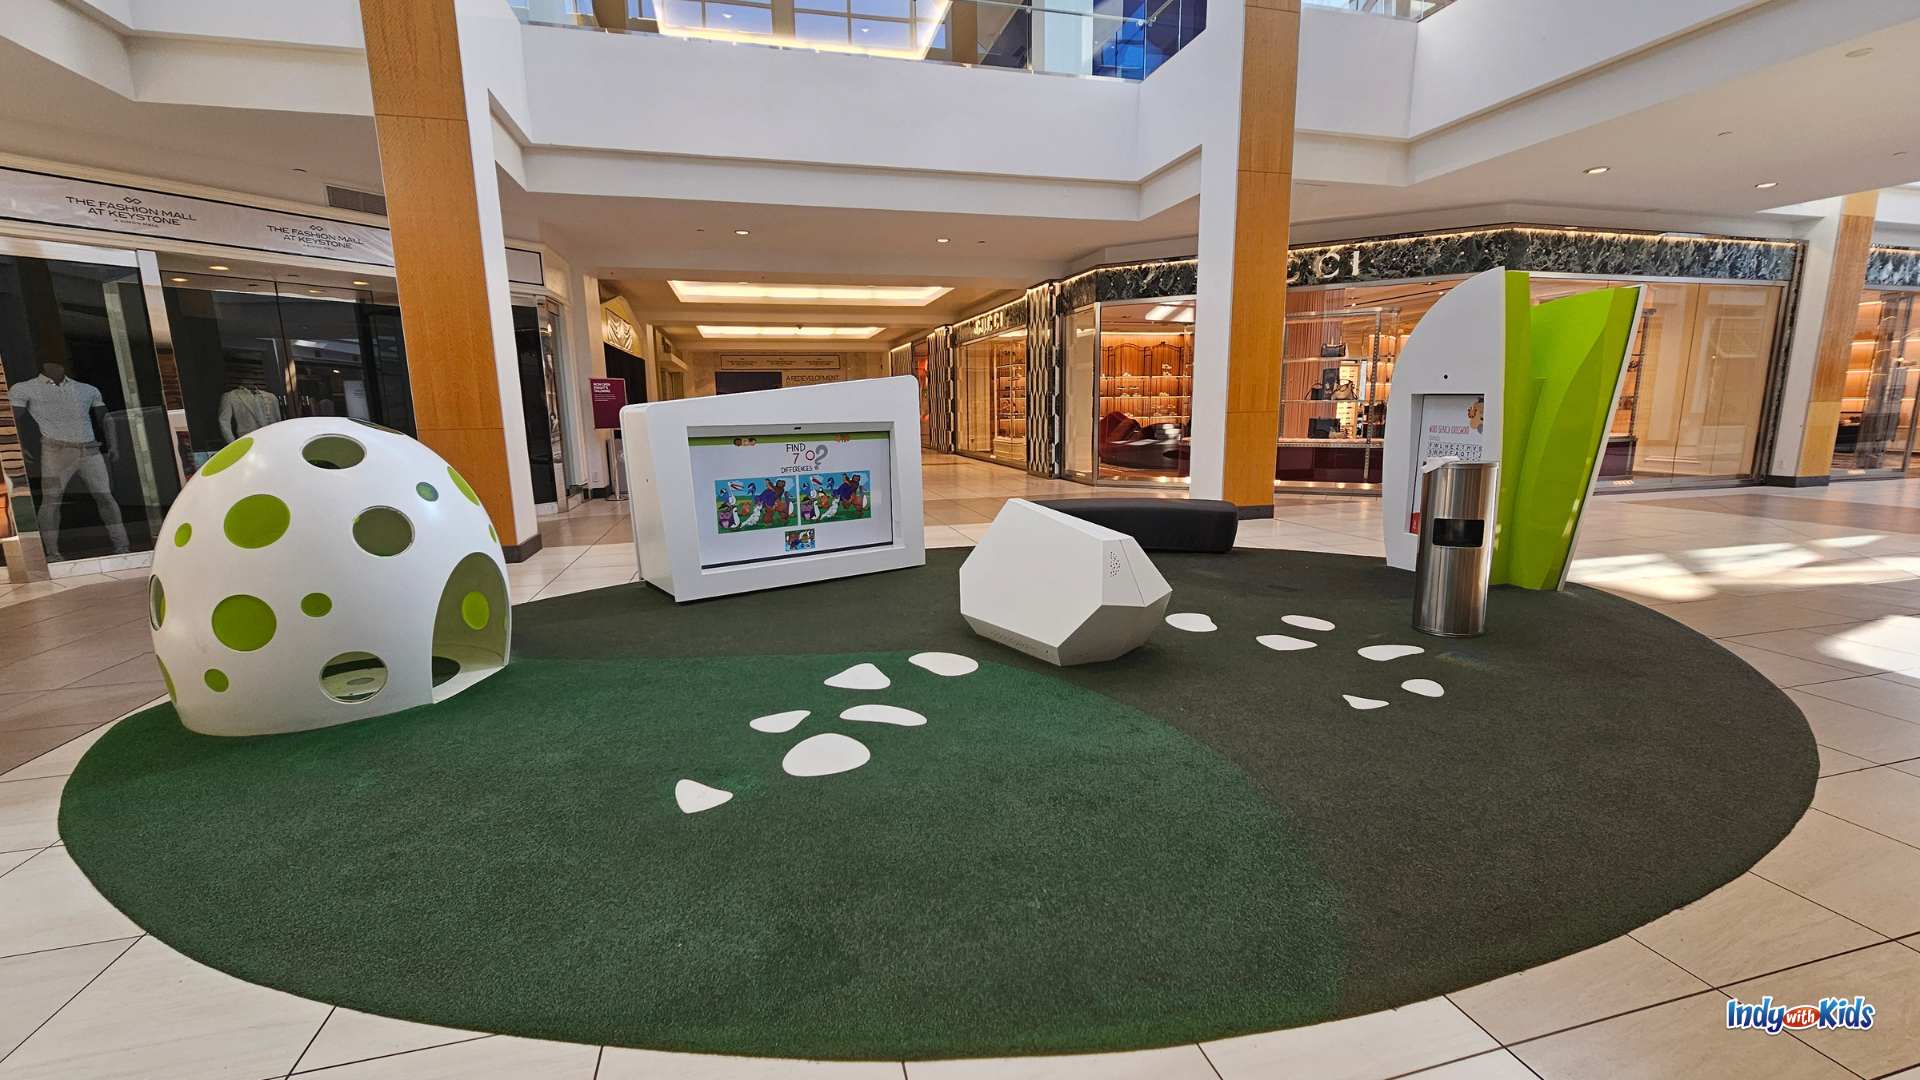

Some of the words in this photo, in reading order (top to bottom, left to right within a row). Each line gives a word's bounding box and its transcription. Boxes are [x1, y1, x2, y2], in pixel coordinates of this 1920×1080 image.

[65, 196, 96, 207] THE
[98, 201, 159, 216] FASHION
[161, 209, 197, 222] MALL
[88, 207, 106, 216] AT
[108, 210, 181, 226] KEYSTONE
[267, 225, 290, 234] THE
[291, 228, 336, 241] FASHION
[338, 235, 363, 245] MALL
[298, 235, 352, 249] KEYSTONE
[973, 311, 1004, 336] GUCCI
[786, 443, 806, 452] FIND
[792, 452, 800, 464] 7
[781, 465, 812, 473] DIFFERENCES
